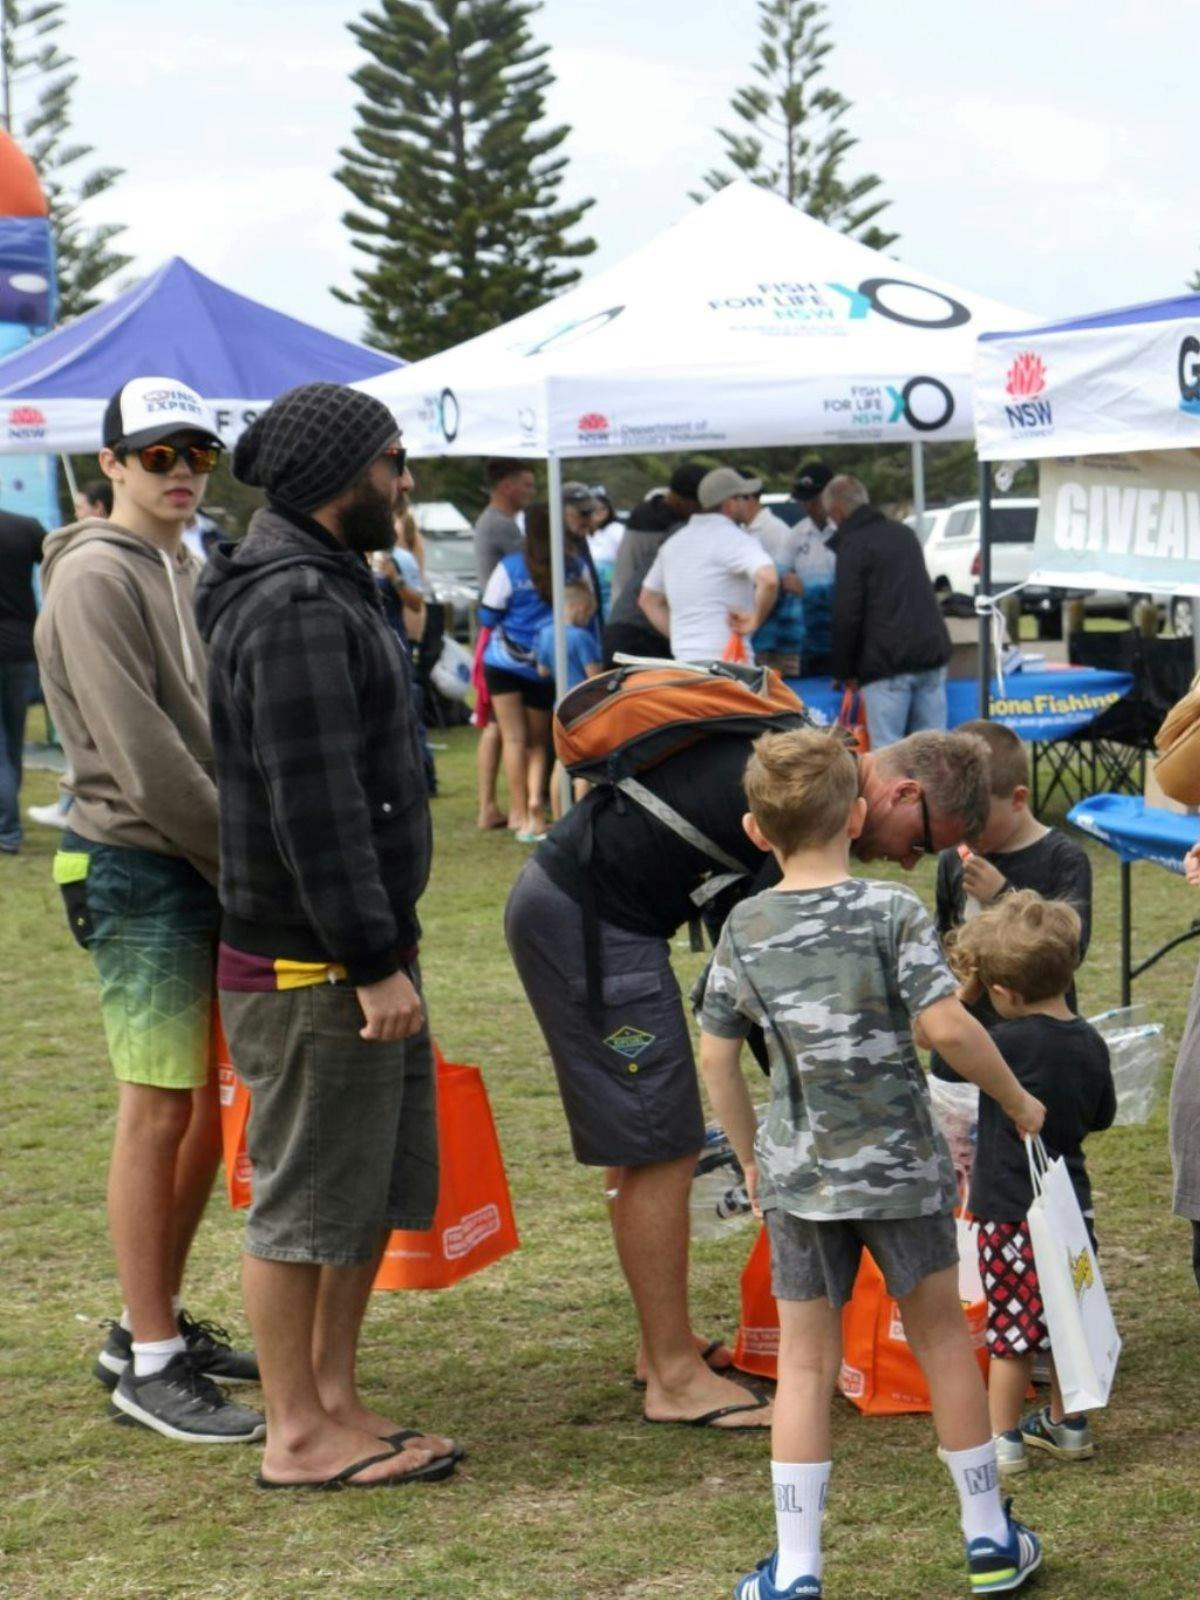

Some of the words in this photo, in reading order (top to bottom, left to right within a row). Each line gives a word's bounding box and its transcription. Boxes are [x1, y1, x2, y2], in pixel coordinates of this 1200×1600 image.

[758, 282, 818, 294] FISH
[708, 296, 764, 310] FOR
[773, 295, 827, 306] LIFE
[851, 386, 882, 397] FISH
[824, 401, 850, 412] FOR
[856, 400, 883, 411] LIFE
[852, 414, 883, 424] NSW
[1005, 399, 1053, 429] NSW
